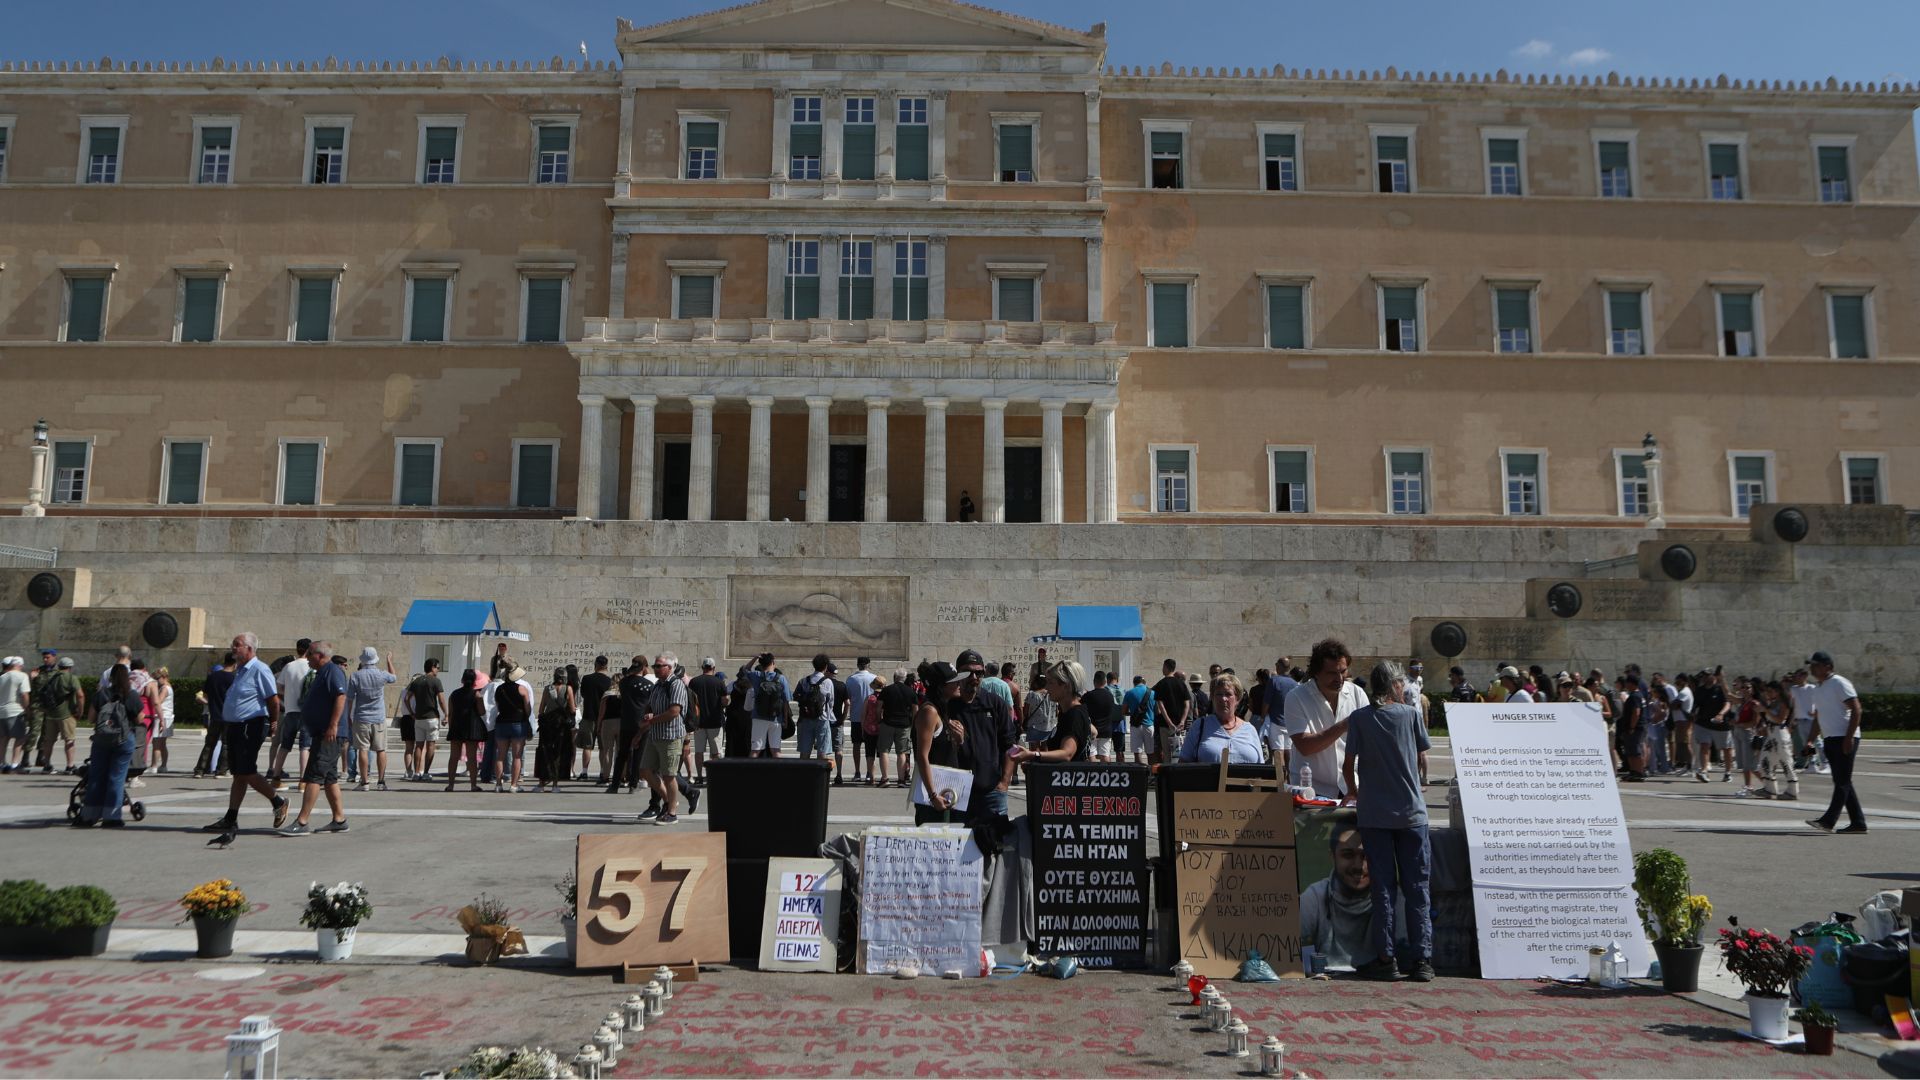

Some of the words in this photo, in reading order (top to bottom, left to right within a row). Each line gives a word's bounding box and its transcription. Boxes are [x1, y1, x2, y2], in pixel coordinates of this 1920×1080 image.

[1052, 772, 1130, 787] 28/2/2023
[1536, 770, 1545, 778] by
[1041, 796, 1076, 815] ΔΕΝ
[1082, 796, 1140, 816] ΞΕΧΝΩ
[1042, 824, 1074, 838] ΣΤΑ
[1080, 824, 1138, 839] ΤΕΜΠΗ
[1493, 829, 1513, 837] grant
[1516, 829, 1560, 837] permission
[933, 840, 952, 850] NOW
[1054, 844, 1084, 858] ΔΕΝ
[1088, 845, 1128, 859] ΗΤΑΝ
[1590, 841, 1599, 849] by
[1530, 854, 1581, 862] immediately
[1044, 870, 1084, 886] ΟΥΤΕ
[1090, 870, 1135, 886] ΘΥΣΙΑ
[595, 856, 709, 933] 57
[1039, 890, 1073, 904] ΟΥΤΕ
[1077, 890, 1140, 904] ΑΤΥΧΗΜΑ
[1556, 892, 1600, 900] permission
[783, 897, 822, 914] ΗΜΕΡΑ
[1497, 905, 1549, 914] investigating
[1600, 905, 1617, 913] they
[778, 920, 821, 935] ΑΠΕΡΓΙΑ
[1038, 916, 1069, 930] ΗΤΑΝ
[1072, 916, 1140, 930] ΔΟΛΟΦΟΝΙΑ
[1492, 918, 1532, 927] destroyed
[1552, 918, 1590, 926] biological
[1583, 931, 1598, 939] just
[1614, 931, 1632, 939] days
[777, 943, 821, 958] ΠΕΙΝΑΣ
[1039, 936, 1054, 951] 57
[1057, 936, 1140, 950] ΑΝΘΡΩΠΙΝΩΝ
